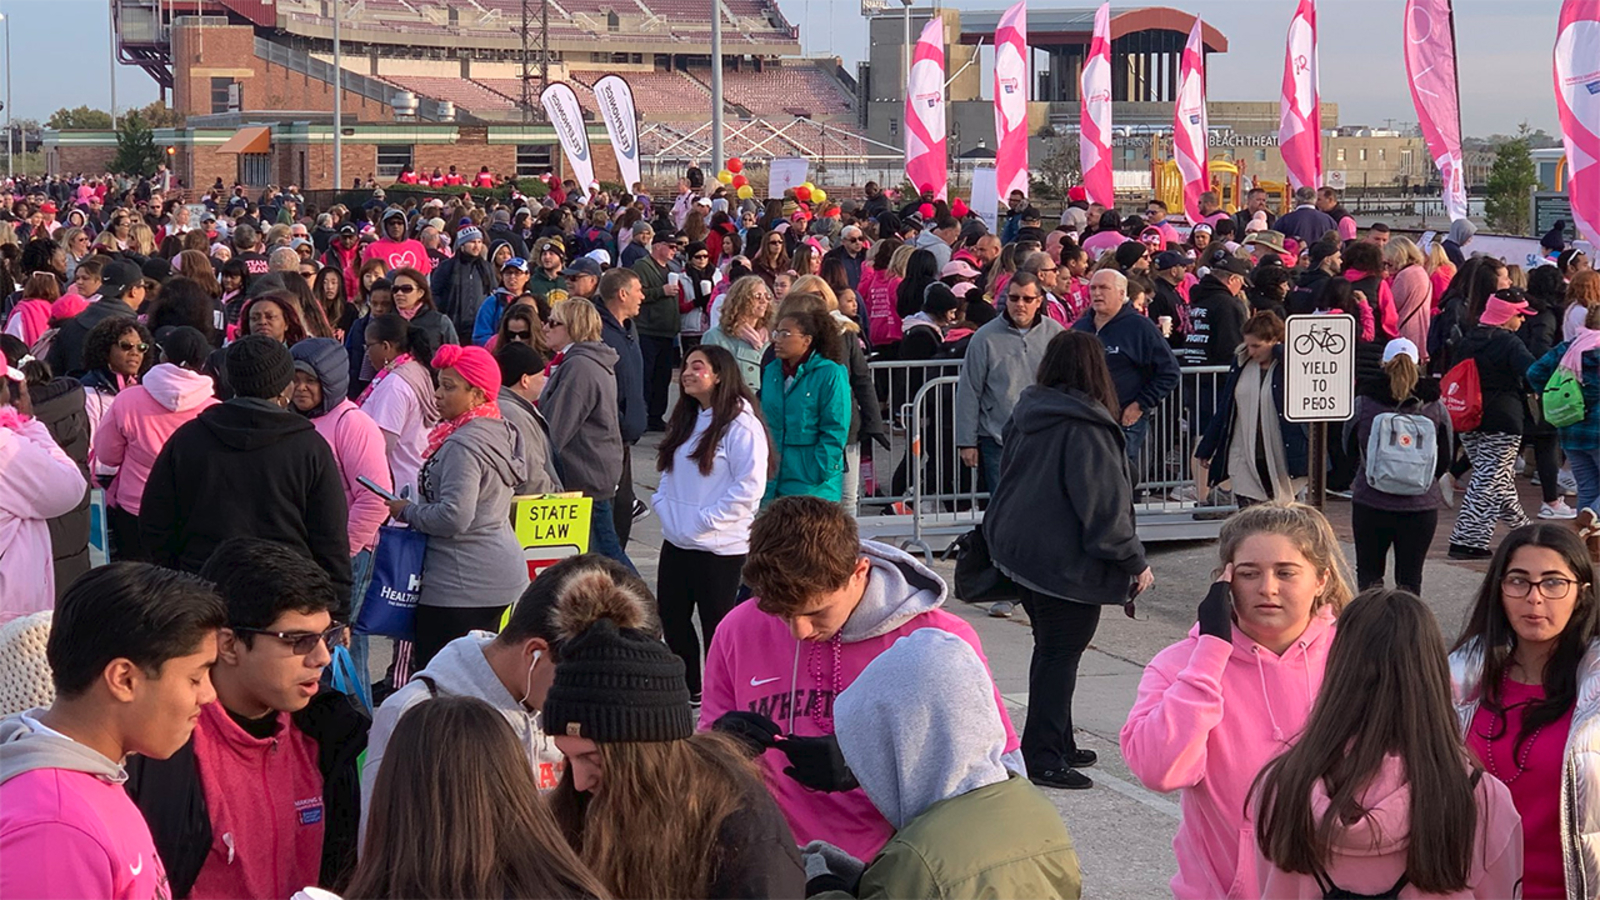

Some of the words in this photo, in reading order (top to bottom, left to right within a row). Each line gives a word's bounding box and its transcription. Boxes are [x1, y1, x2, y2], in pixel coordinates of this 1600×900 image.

[1209, 136, 1245, 147] BEACH
[1302, 361, 1338, 375] YIELD
[1312, 379, 1327, 392] TO
[1303, 396, 1336, 410] PEDS
[529, 504, 579, 521] STATE
[535, 523, 570, 540] LAW
